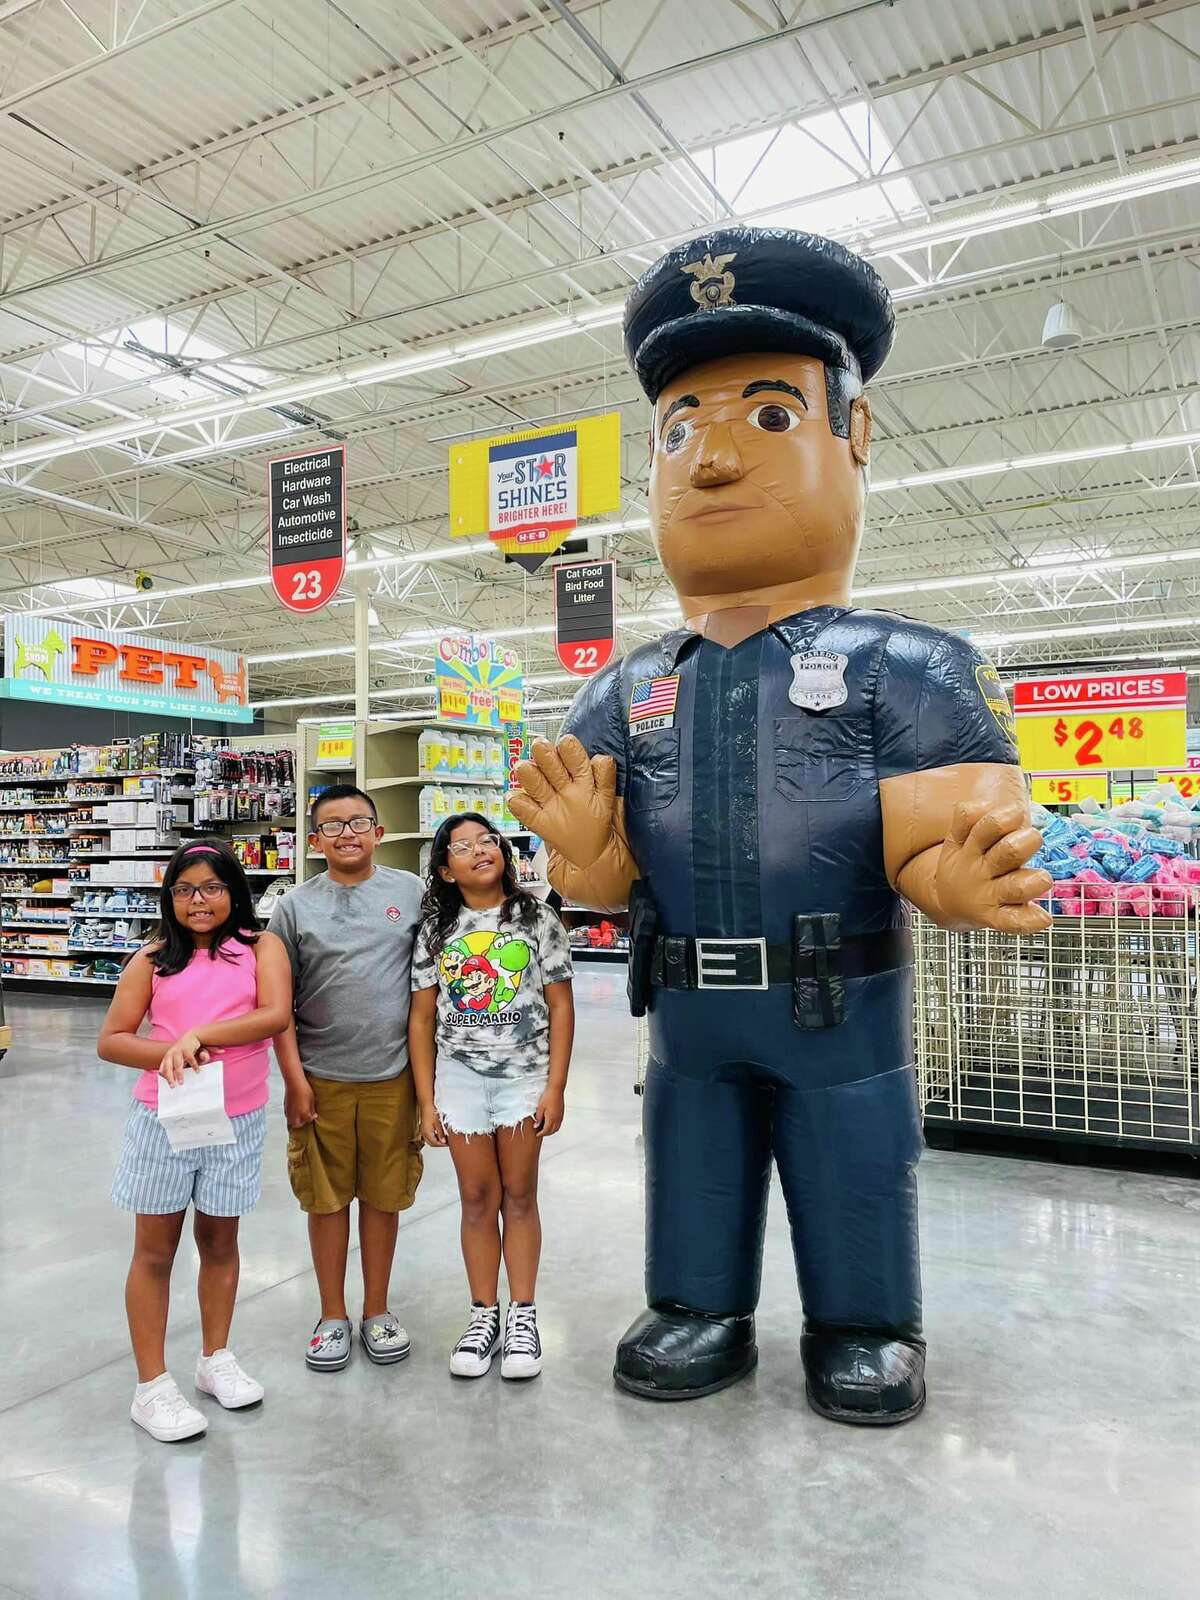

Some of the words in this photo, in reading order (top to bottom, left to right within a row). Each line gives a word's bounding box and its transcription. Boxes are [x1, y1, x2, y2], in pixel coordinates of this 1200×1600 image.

[284, 455, 331, 475] Electrical
[282, 475, 332, 493] Hardware
[497, 471, 514, 483] Your
[282, 497, 300, 511] Car
[302, 491, 331, 507] Wash
[498, 481, 567, 510] SHINES
[278, 509, 336, 528] Automotive
[498, 507, 539, 524] BRIGHTER
[542, 503, 567, 517] HERE!
[278, 527, 333, 546] Insecticide
[566, 570, 580, 579] Cat
[582, 566, 602, 577] Food
[291, 570, 322, 601] 23
[565, 581, 582, 591] Bird
[584, 579, 604, 589] Food
[573, 593, 595, 603] Litter
[71, 637, 207, 688] PET
[573, 647, 598, 668] 22
[800, 651, 839, 662] LAREDO
[1032, 683, 1082, 701] LOW
[1087, 679, 1165, 698] PRICES
[29, 686, 52, 696] WE
[56, 688, 102, 701] TREAT
[106, 694, 140, 705] YOUR
[143, 699, 166, 709] PET
[170, 702, 197, 712] LIKE
[200, 705, 239, 716] FAMILY
[636, 718, 665, 732] POLICE
[446, 1012, 478, 1025] SUPER
[480, 1011, 521, 1024] MARIO
